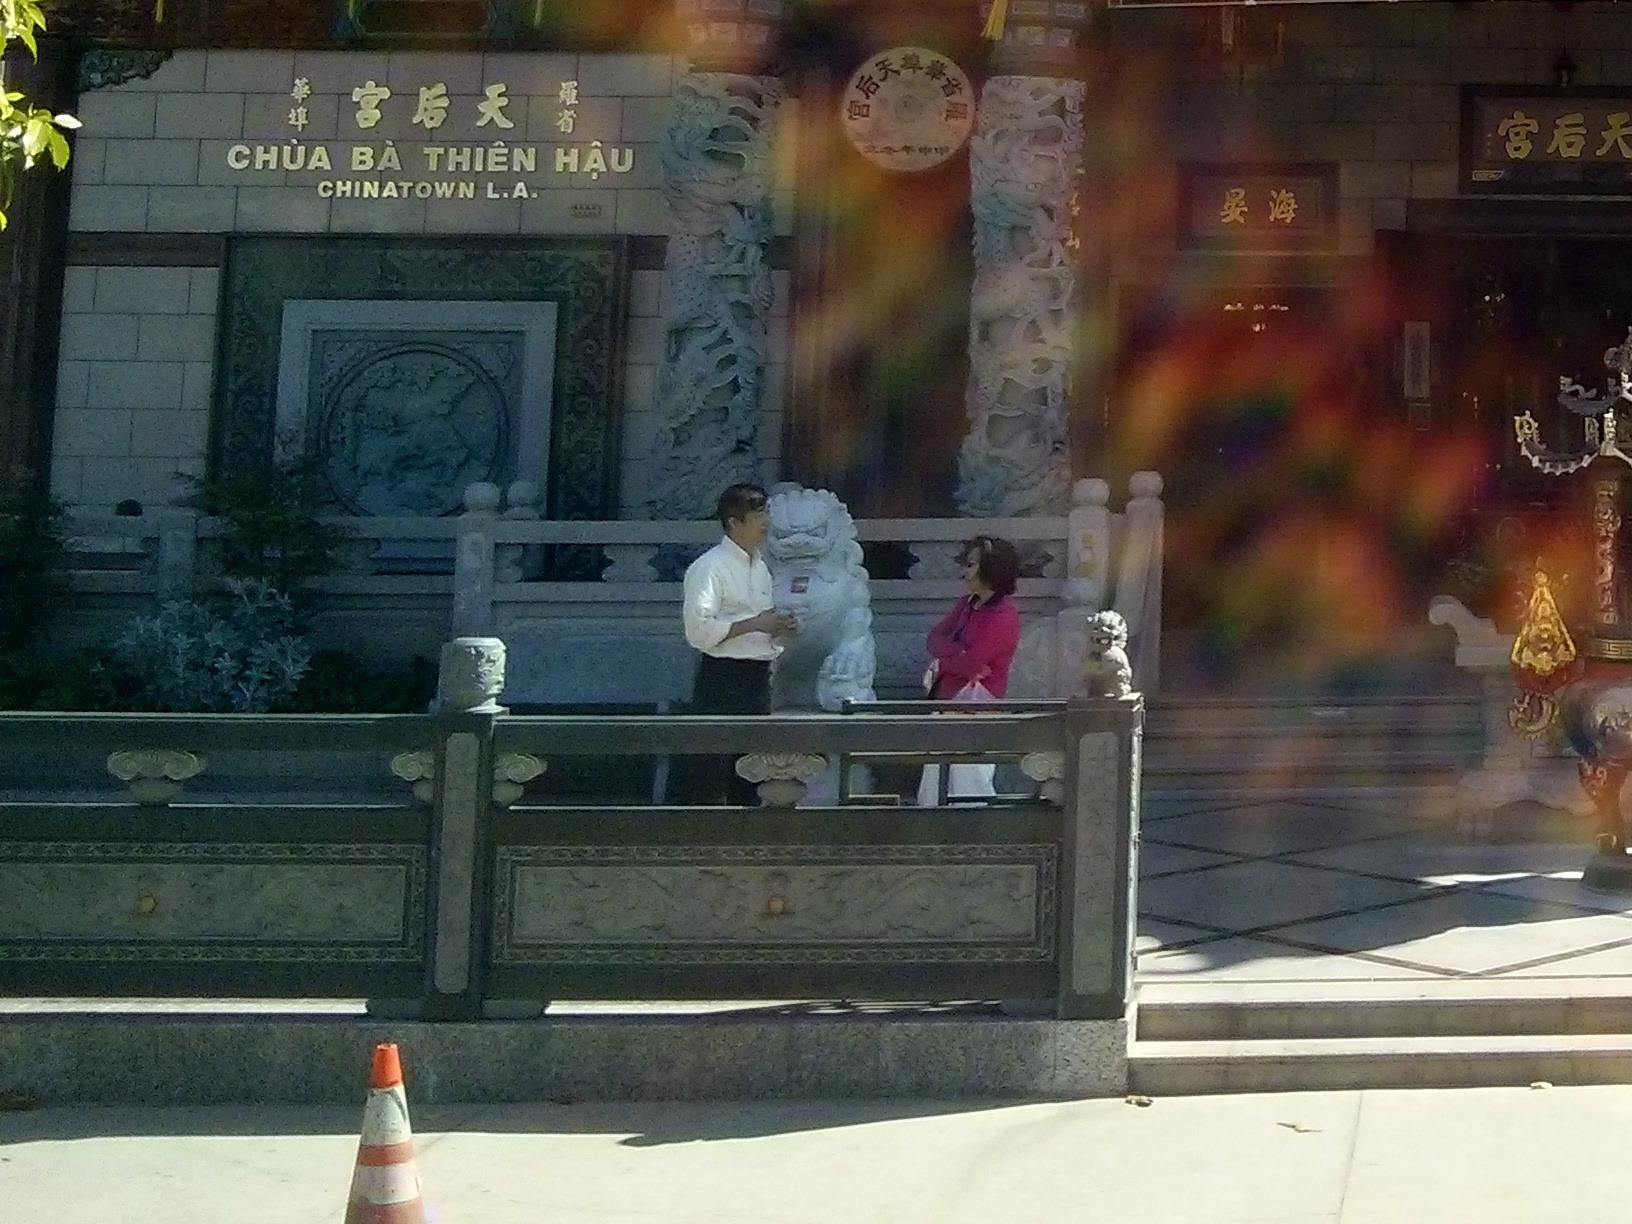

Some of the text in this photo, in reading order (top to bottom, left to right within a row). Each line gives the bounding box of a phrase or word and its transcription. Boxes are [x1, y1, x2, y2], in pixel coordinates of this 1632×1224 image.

[350, 80, 515, 130] 天后宮
[227, 139, 636, 180] CHÙA BÀ THIÊN HẬU
[317, 180, 539, 200] CHINATOWN L.A.
